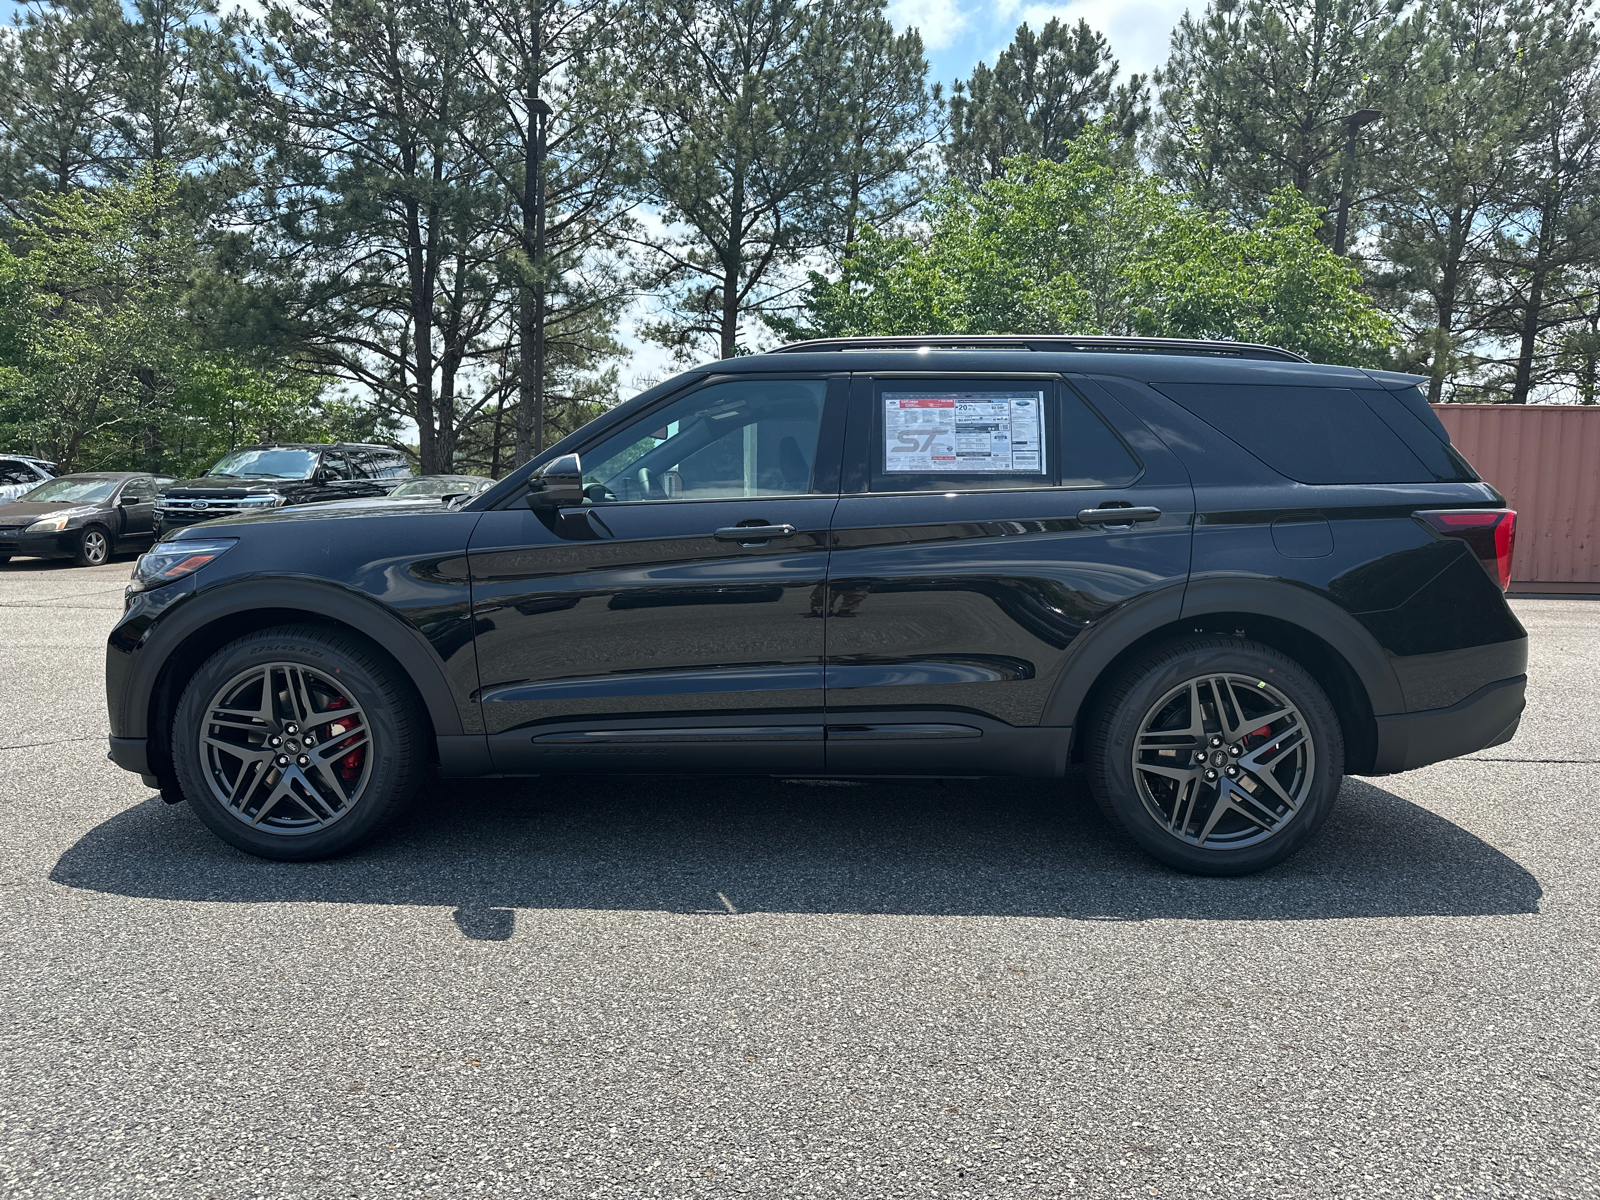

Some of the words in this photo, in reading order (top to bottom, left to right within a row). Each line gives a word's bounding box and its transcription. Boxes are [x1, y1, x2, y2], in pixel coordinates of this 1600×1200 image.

[890, 429, 950, 453] ST
[249, 644, 297, 655] 275/45
[299, 647, 325, 658] R21
[1113, 706, 1137, 749] PIRELLI
[1271, 667, 1328, 725] CORPION
[1324, 730, 1335, 778] ZERO
[179, 743, 195, 788] ZERO
[543, 747, 668, 756] EXPLORER
[374, 756, 393, 795] PIRELLI
